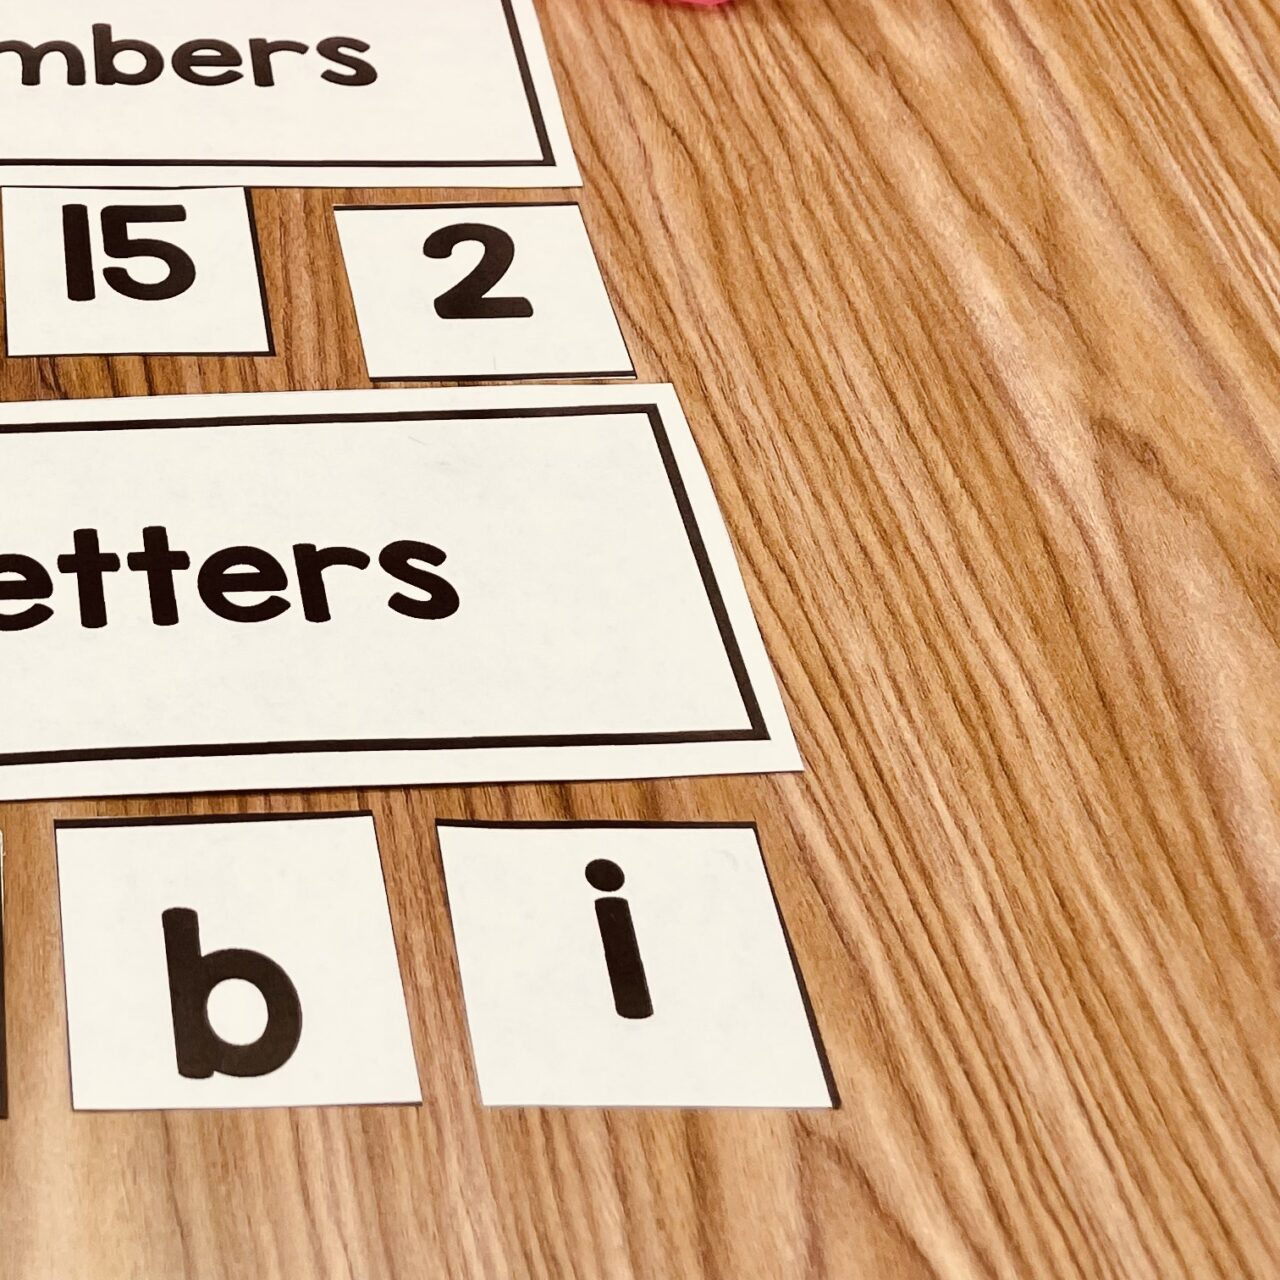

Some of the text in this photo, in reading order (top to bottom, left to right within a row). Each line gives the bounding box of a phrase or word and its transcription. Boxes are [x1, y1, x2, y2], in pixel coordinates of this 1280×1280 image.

[62, 203, 197, 302] 15
[422, 222, 534, 320] 2
[161, 907, 303, 1080] b
[584, 858, 654, 1020] i
